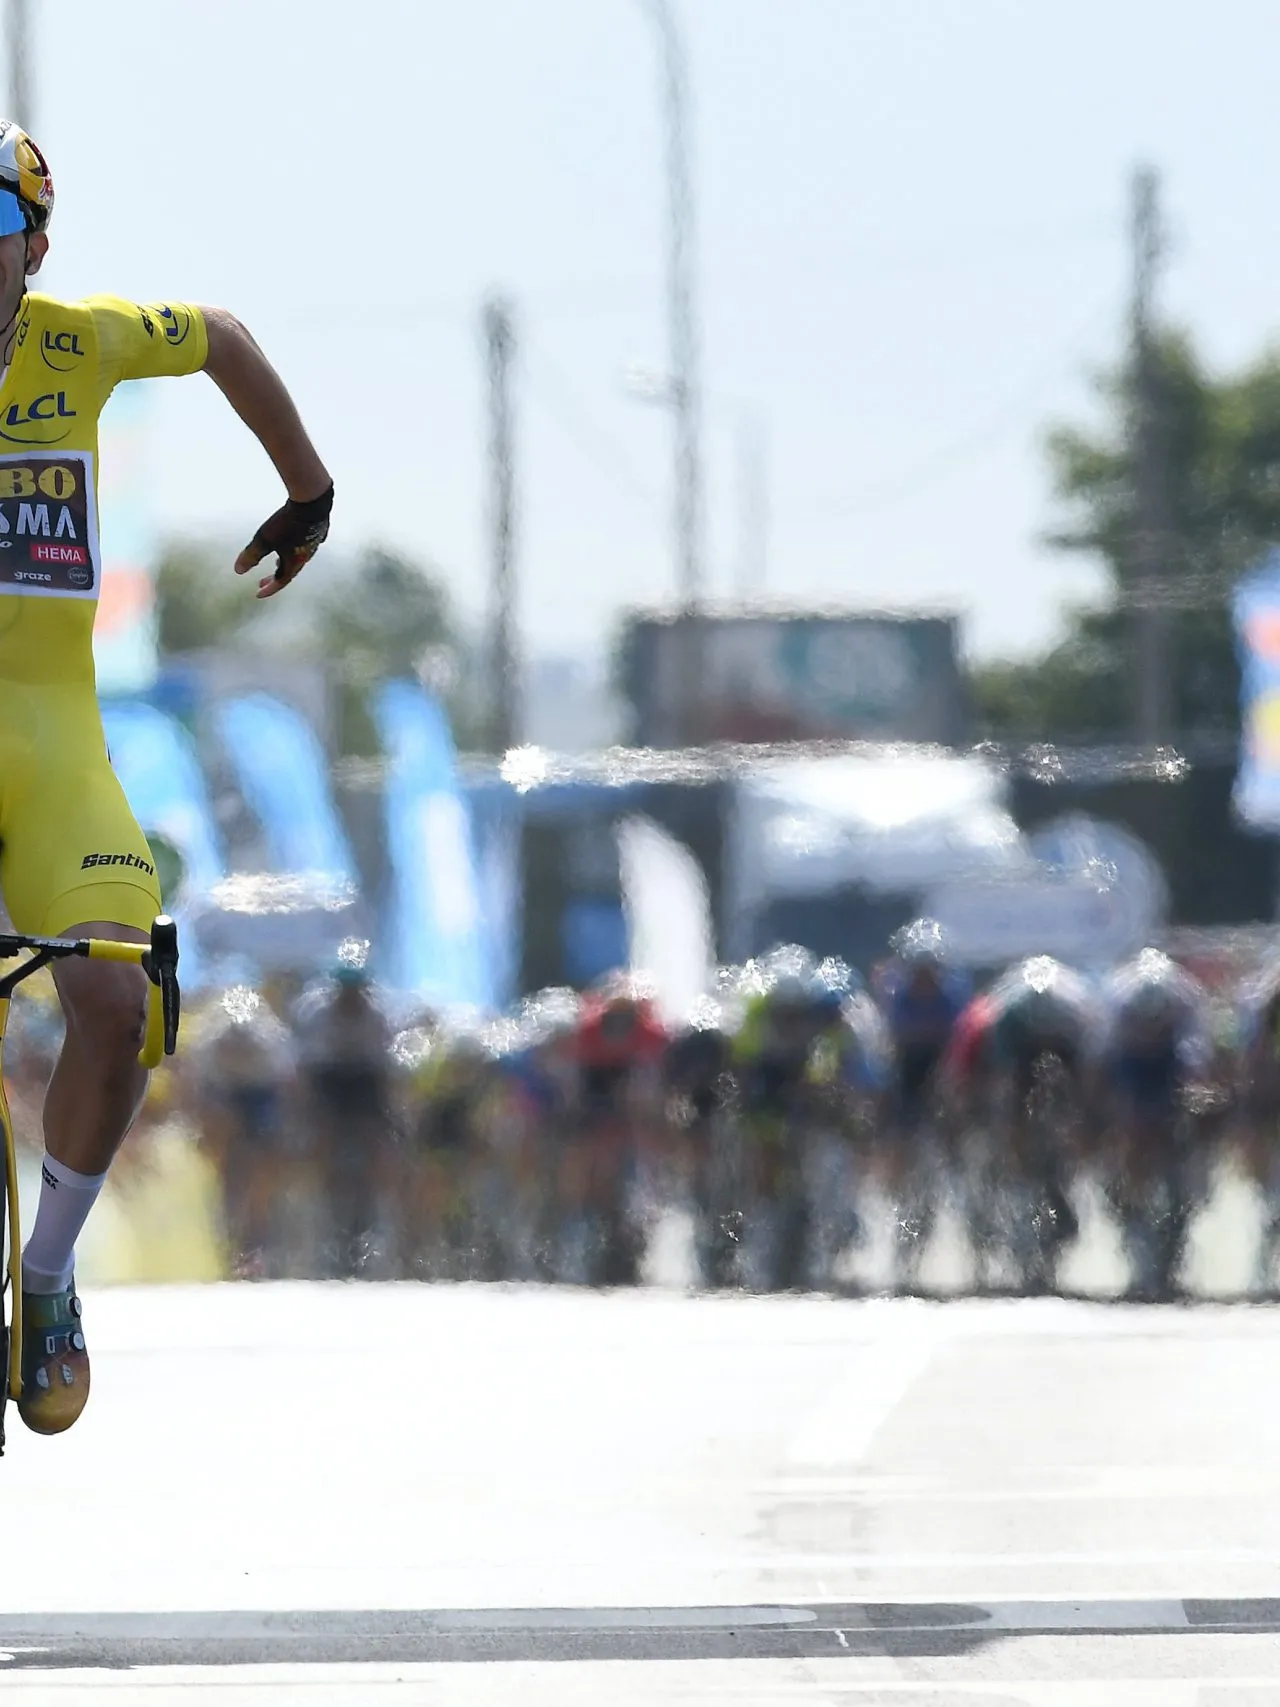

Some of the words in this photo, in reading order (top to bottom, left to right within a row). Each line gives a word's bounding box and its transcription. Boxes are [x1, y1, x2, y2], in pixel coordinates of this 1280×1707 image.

[44, 330, 84, 356] LCL
[6, 391, 76, 425] LCL
[38, 547, 82, 562] HEMA
[14, 570, 52, 581] graze
[81, 853, 154, 876] Santini
